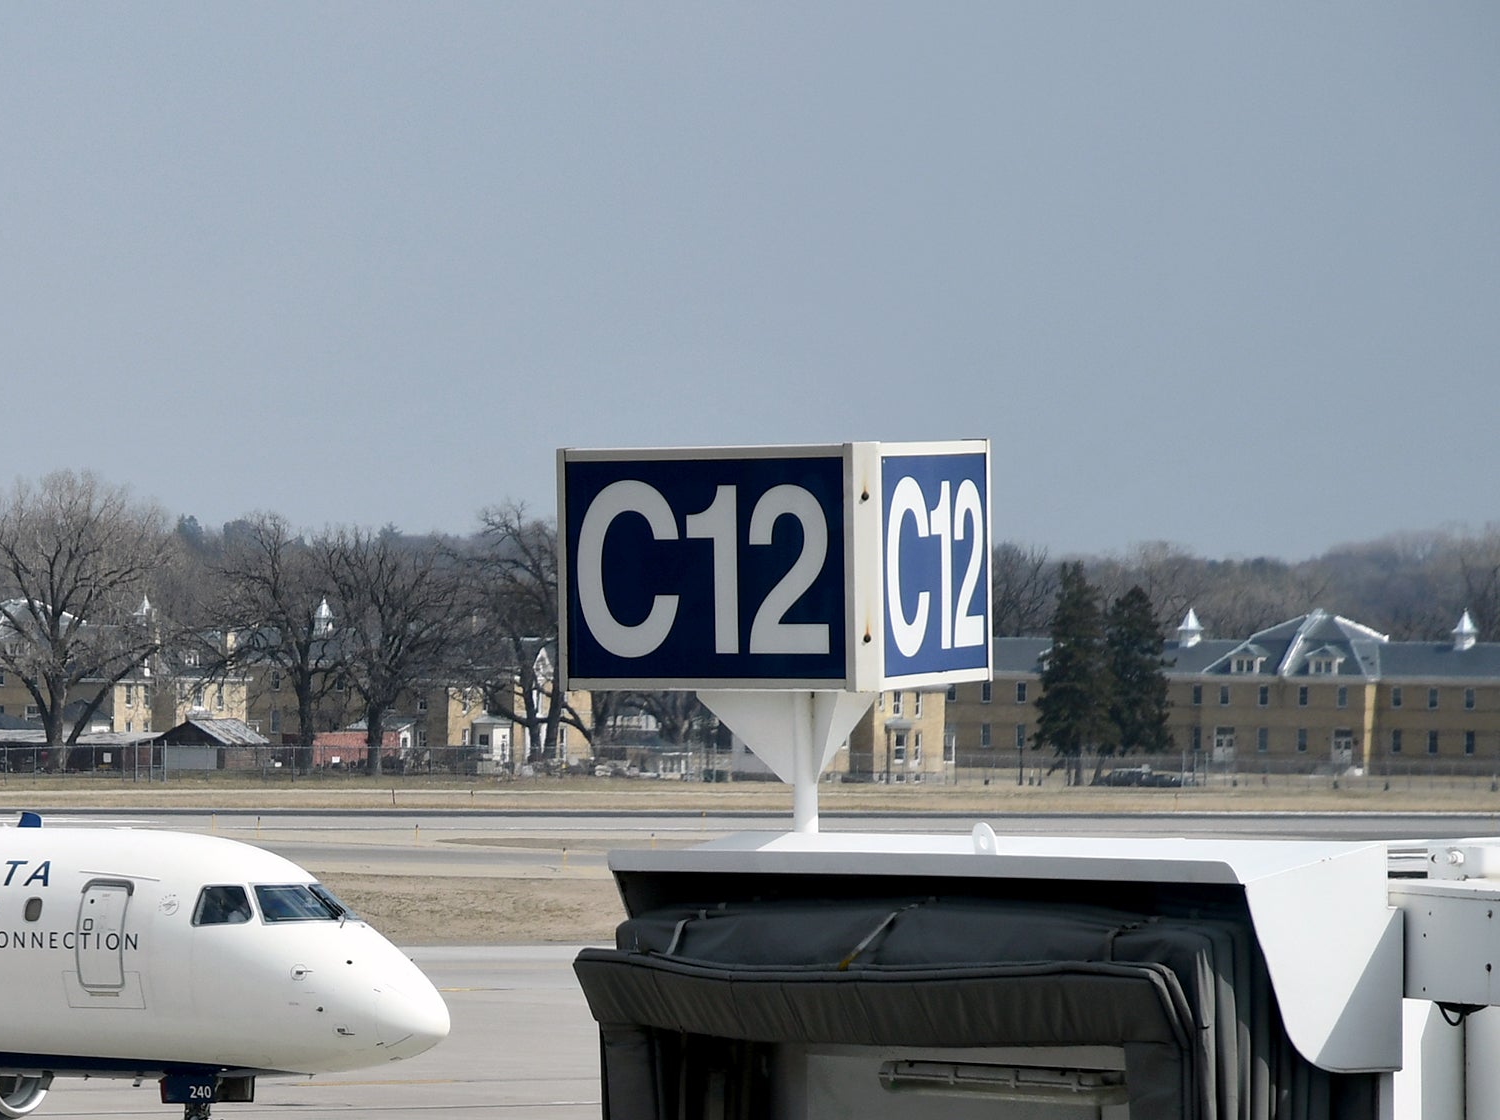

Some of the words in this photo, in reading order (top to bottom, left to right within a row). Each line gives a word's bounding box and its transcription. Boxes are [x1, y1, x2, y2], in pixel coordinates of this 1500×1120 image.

[577, 479, 830, 658] C12
[886, 475, 985, 658] C12
[189, 1085, 212, 1099] 240
